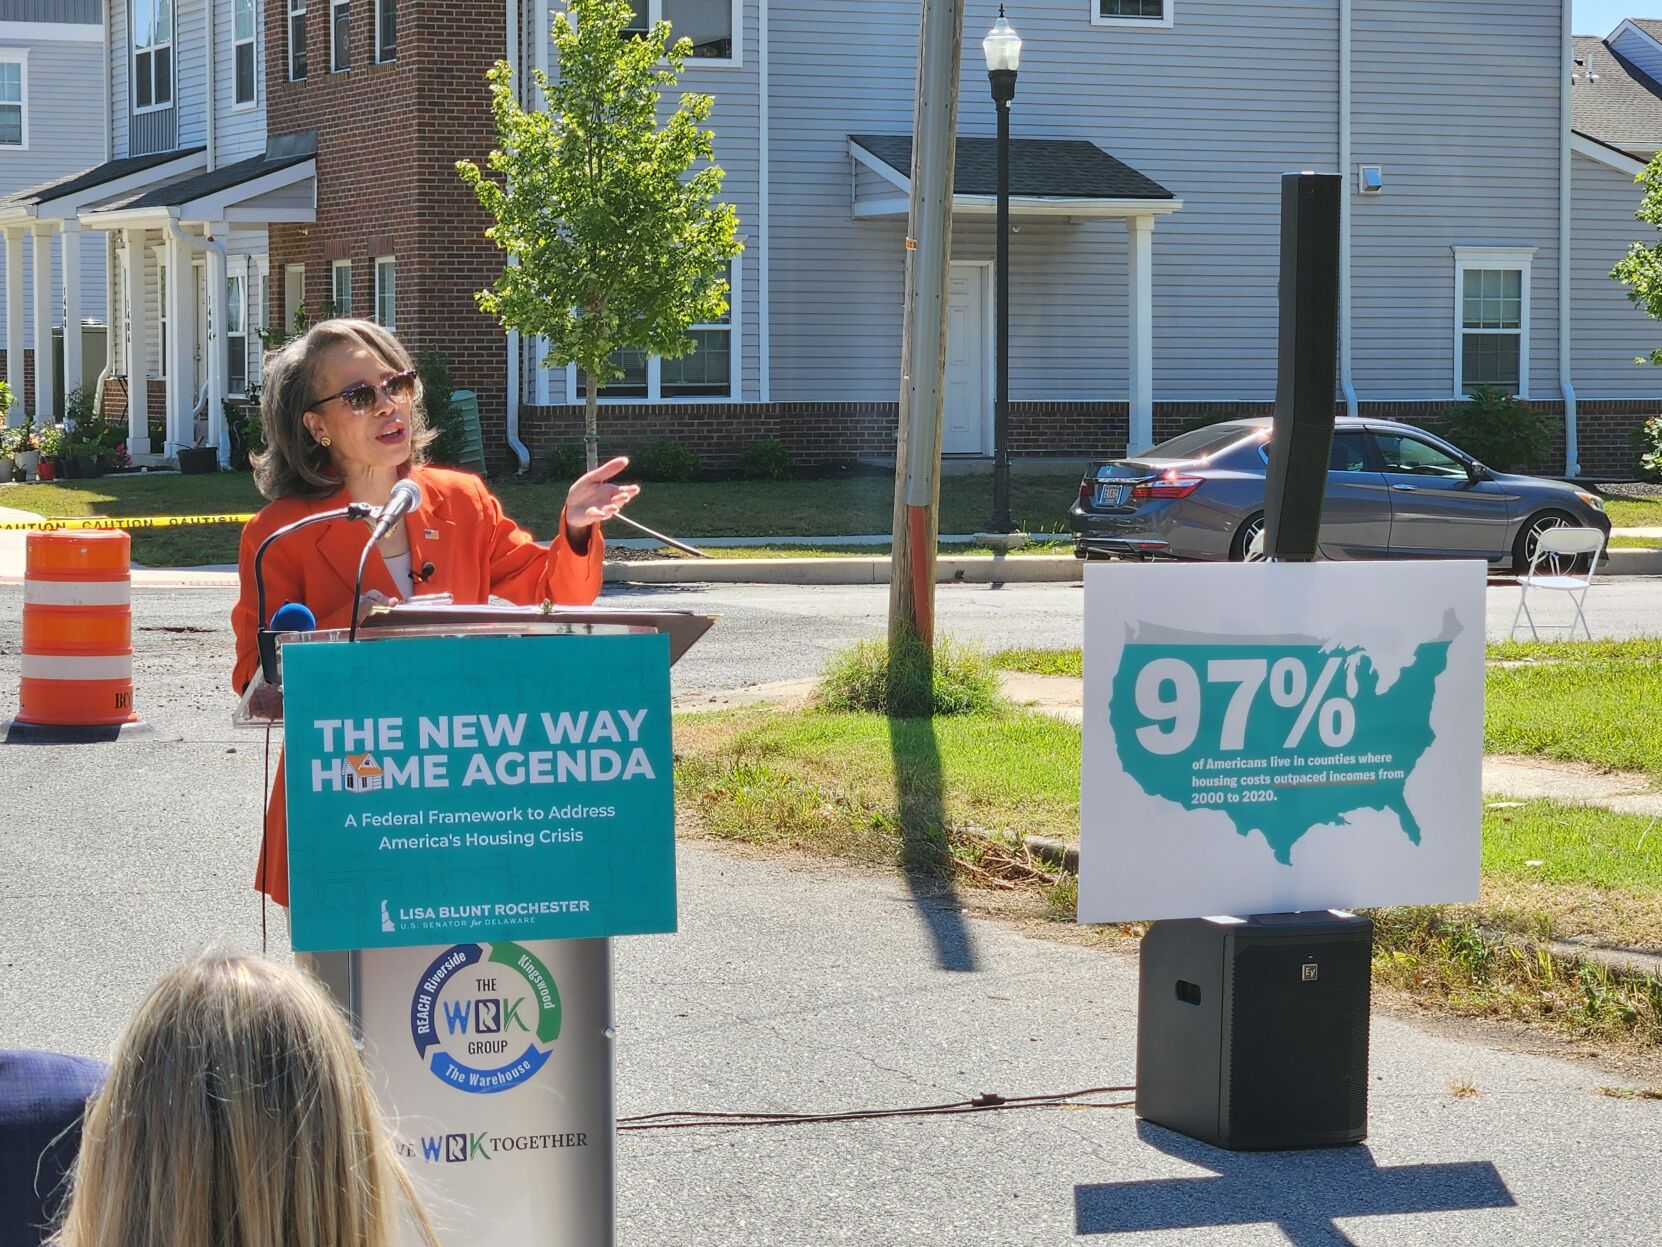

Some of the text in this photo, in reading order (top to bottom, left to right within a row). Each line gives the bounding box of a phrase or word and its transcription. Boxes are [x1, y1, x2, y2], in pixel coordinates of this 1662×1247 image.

[1134, 656, 1356, 755] 97%
[313, 708, 648, 753] THE NEW WAY
[311, 747, 656, 793] HME AGENDA
[1192, 752, 1393, 770] of Americans live in counties where
[1192, 768, 1405, 788] housing costs outpaced incomes from
[1191, 789, 1278, 804] 2000 to 2020.
[344, 803, 616, 828] A Federal Framework to Address
[378, 827, 584, 850] America's Housing Crisis
[400, 900, 590, 920] LISA BLUNT ROCHESTER
[400, 917, 536, 930] U.S. SENATOR for DELAWARE
[417, 951, 467, 1034] REACH Riverside
[476, 978, 497, 992] THE
[517, 954, 556, 1009] Kingswood
[443, 997, 531, 1036] WRK
[468, 1040, 508, 1054] GROUP
[445, 1060, 531, 1087] The Warehouse
[490, 1132, 588, 1152] TOGETHER
